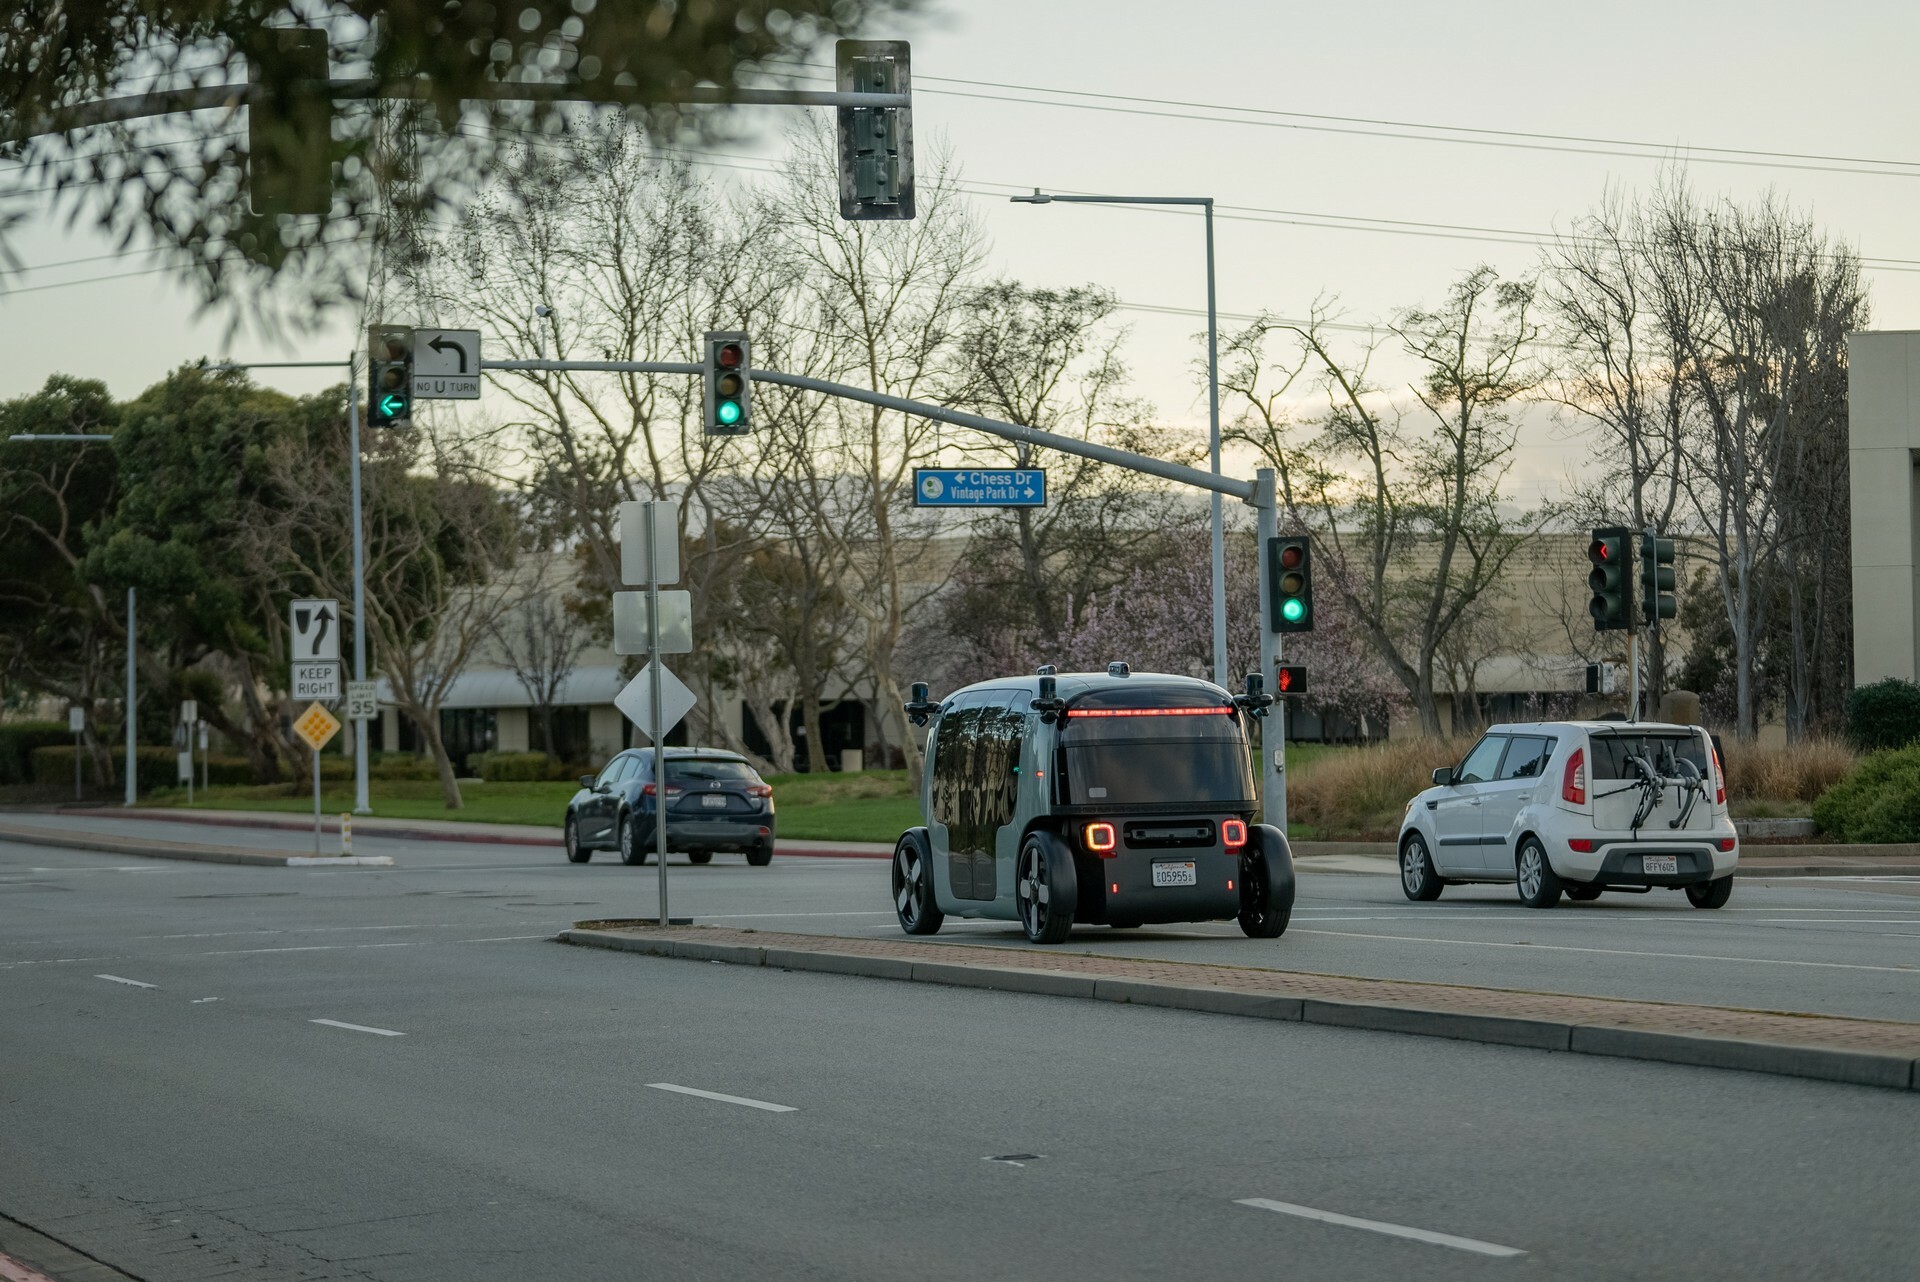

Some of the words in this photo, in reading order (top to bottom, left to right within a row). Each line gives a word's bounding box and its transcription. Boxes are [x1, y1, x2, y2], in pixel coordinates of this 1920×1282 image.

[417, 382, 430, 391] NO
[435, 380, 445, 393] U
[450, 383, 476, 392] TURN
[970, 472, 1012, 485] Chess
[1016, 472, 1032, 485] Dr
[951, 486, 984, 502] Vintage
[986, 486, 1006, 499] Park
[1009, 486, 1019, 499] Dr
[300, 668, 332, 679] KEEP
[298, 683, 334, 694] RIGHT
[352, 701, 374, 715] 35
[1161, 871, 1188, 882] 05955
